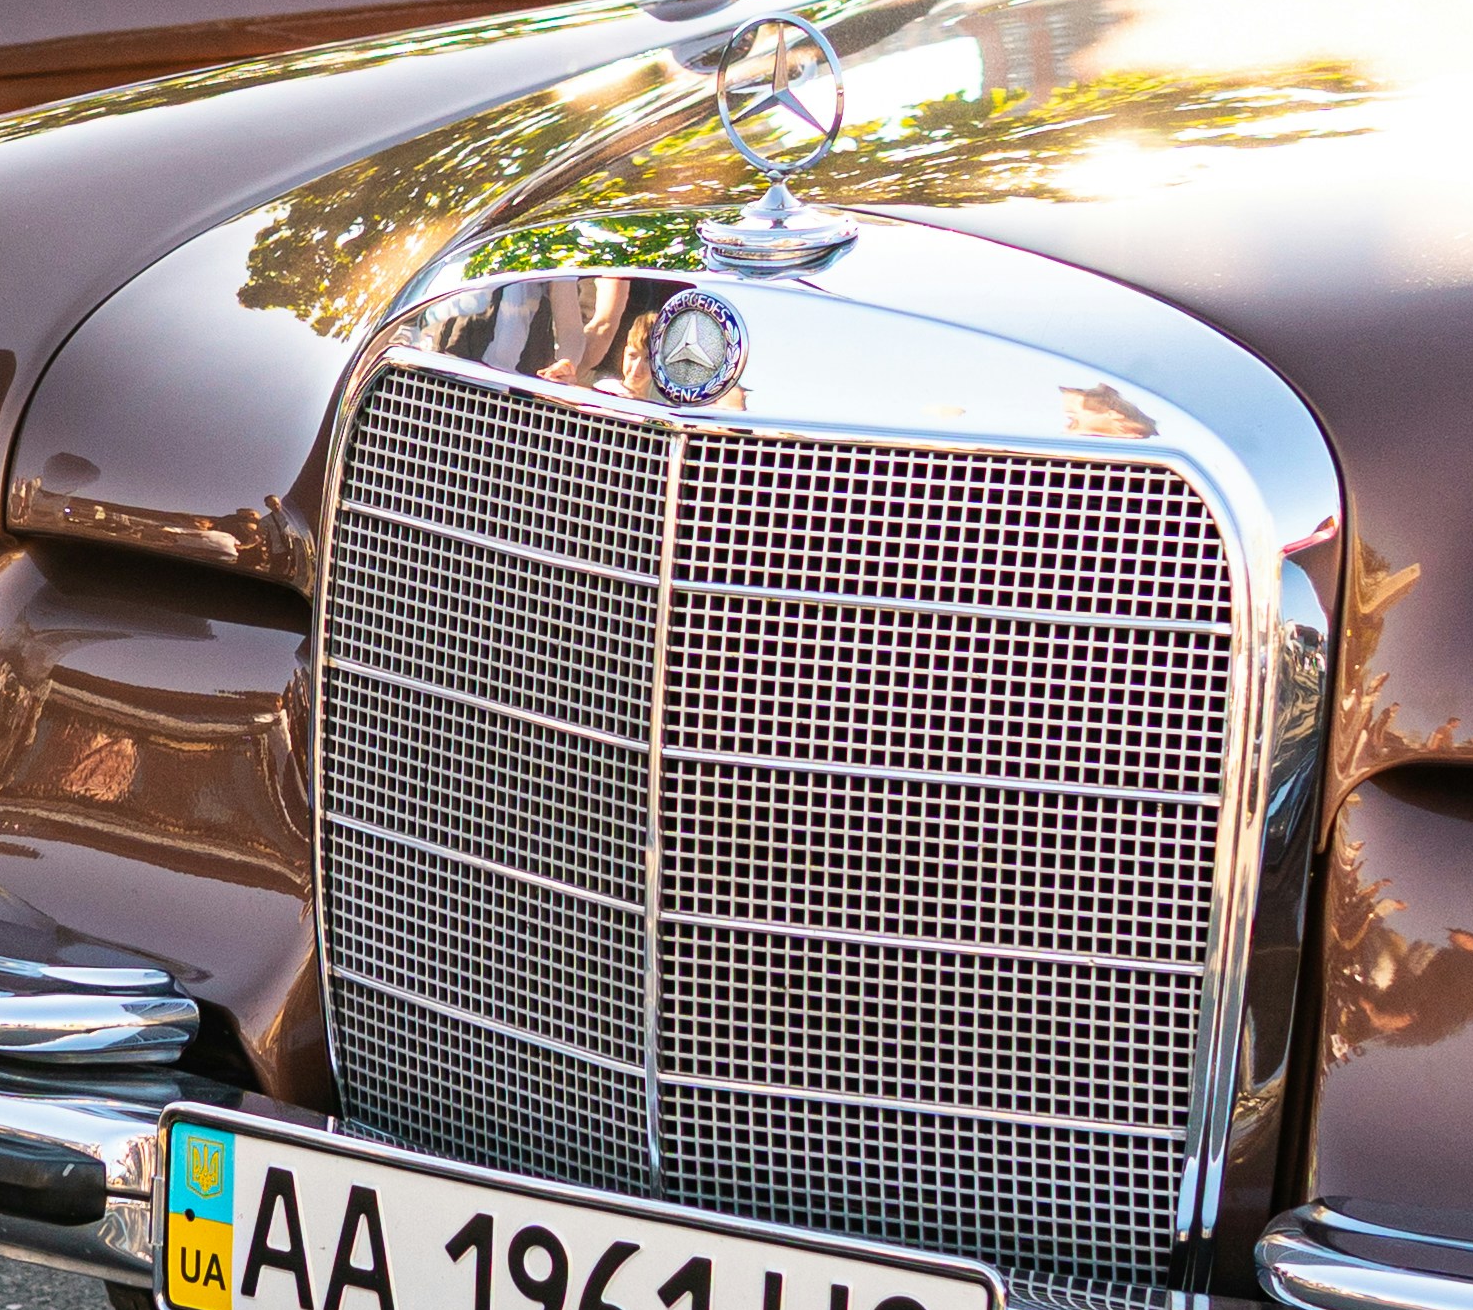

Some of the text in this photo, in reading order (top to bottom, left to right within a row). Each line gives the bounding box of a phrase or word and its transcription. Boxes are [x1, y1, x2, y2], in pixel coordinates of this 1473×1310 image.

[665, 291, 731, 323] MERCEDES
[665, 385, 704, 403] BENZ
[180, 1246, 227, 1291] UA
